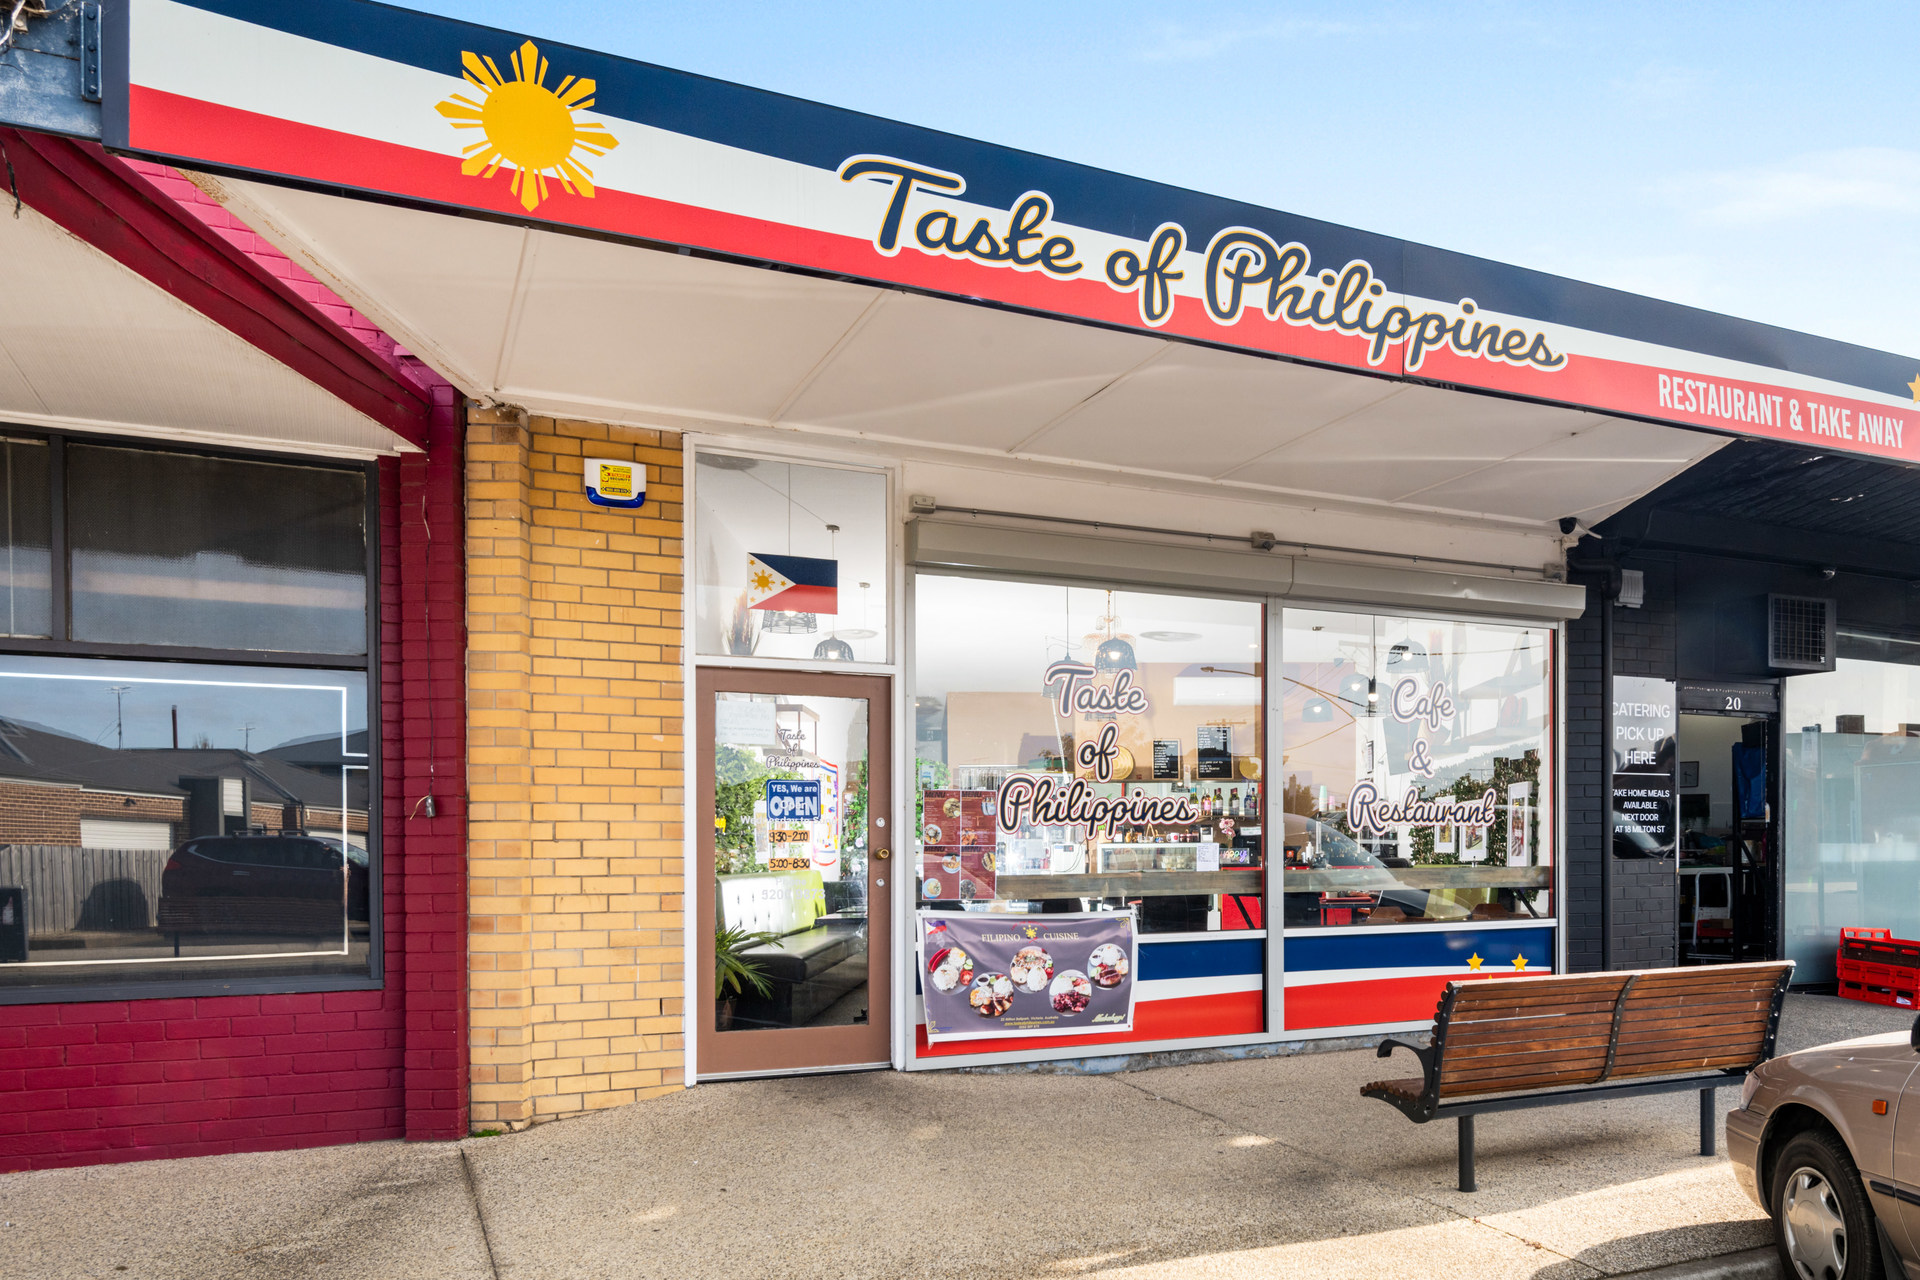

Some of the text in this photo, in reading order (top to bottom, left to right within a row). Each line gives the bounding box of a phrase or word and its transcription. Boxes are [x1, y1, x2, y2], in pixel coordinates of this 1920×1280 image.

[838, 156, 1567, 370] Taste of Philippines
[1657, 373, 1904, 449] RESTAURANT & TAKE AWAY
[1045, 665, 1148, 717] Taste
[1391, 677, 1456, 732] Cafe
[1725, 696, 1741, 710] 20
[777, 728, 806, 740] Taste
[1616, 726, 1665, 741] PICK UP
[787, 743, 798, 757] of
[1078, 723, 1119, 783] of
[1624, 750, 1656, 765] HERE
[766, 755, 821, 771] Philippines
[1409, 738, 1434, 778] &
[771, 784, 789, 794] YES,
[790, 784, 803, 792] We
[1628, 789, 1647, 797] HOME
[1648, 789, 1670, 798] MEALS
[769, 795, 818, 816] OPEN
[998, 774, 1198, 840] Philippines
[1347, 780, 1496, 836] Restaurant
[1623, 801, 1658, 809] AVAILABLE
[1621, 813, 1659, 821] NEXT DOOR
[1614, 825, 1666, 833] AT 18 MILTON ST
[795, 888, 825, 900] 9873
[981, 932, 1080, 942] FILIPINO CUISINE
